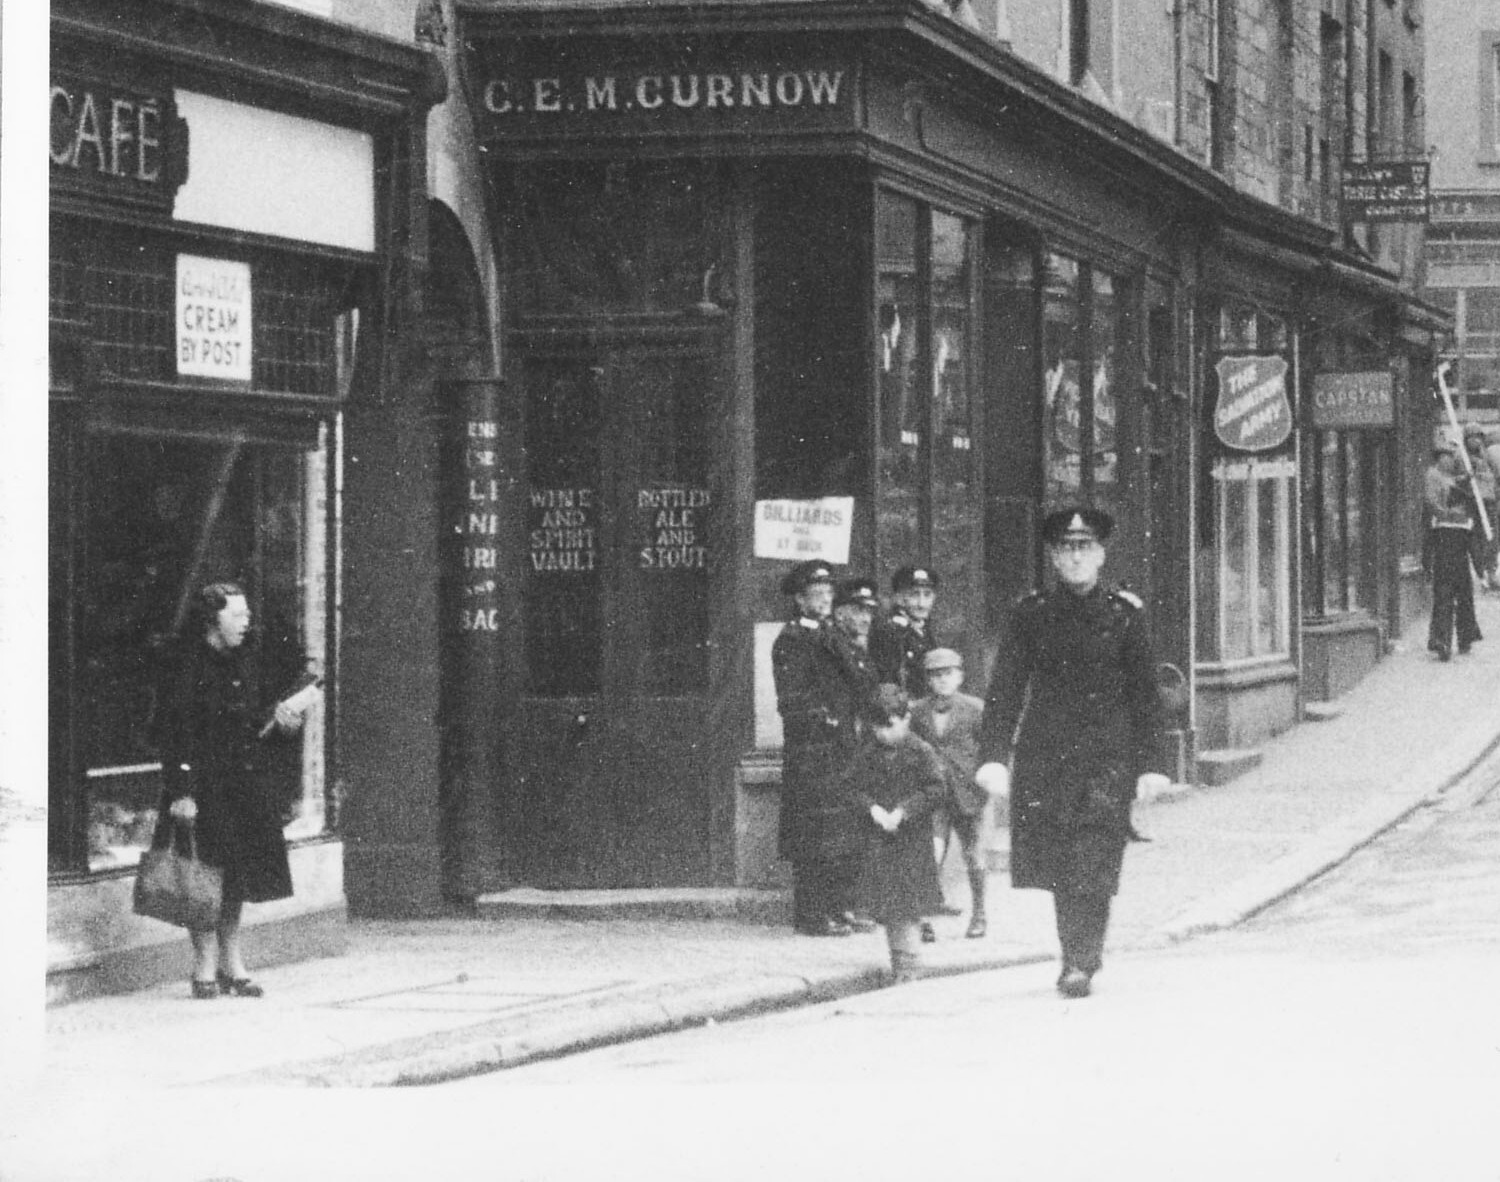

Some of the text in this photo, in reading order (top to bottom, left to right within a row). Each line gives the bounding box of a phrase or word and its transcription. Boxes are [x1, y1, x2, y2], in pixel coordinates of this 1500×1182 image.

[635, 70, 845, 109] CURNOW
[183, 303, 240, 334] CREAM
[181, 337, 242, 367] BY POST
[530, 488, 593, 508] WINE
[542, 509, 586, 528] AND
[656, 509, 694, 528] ALE
[656, 529, 695, 546] AND
[640, 547, 706, 568] STOUT
